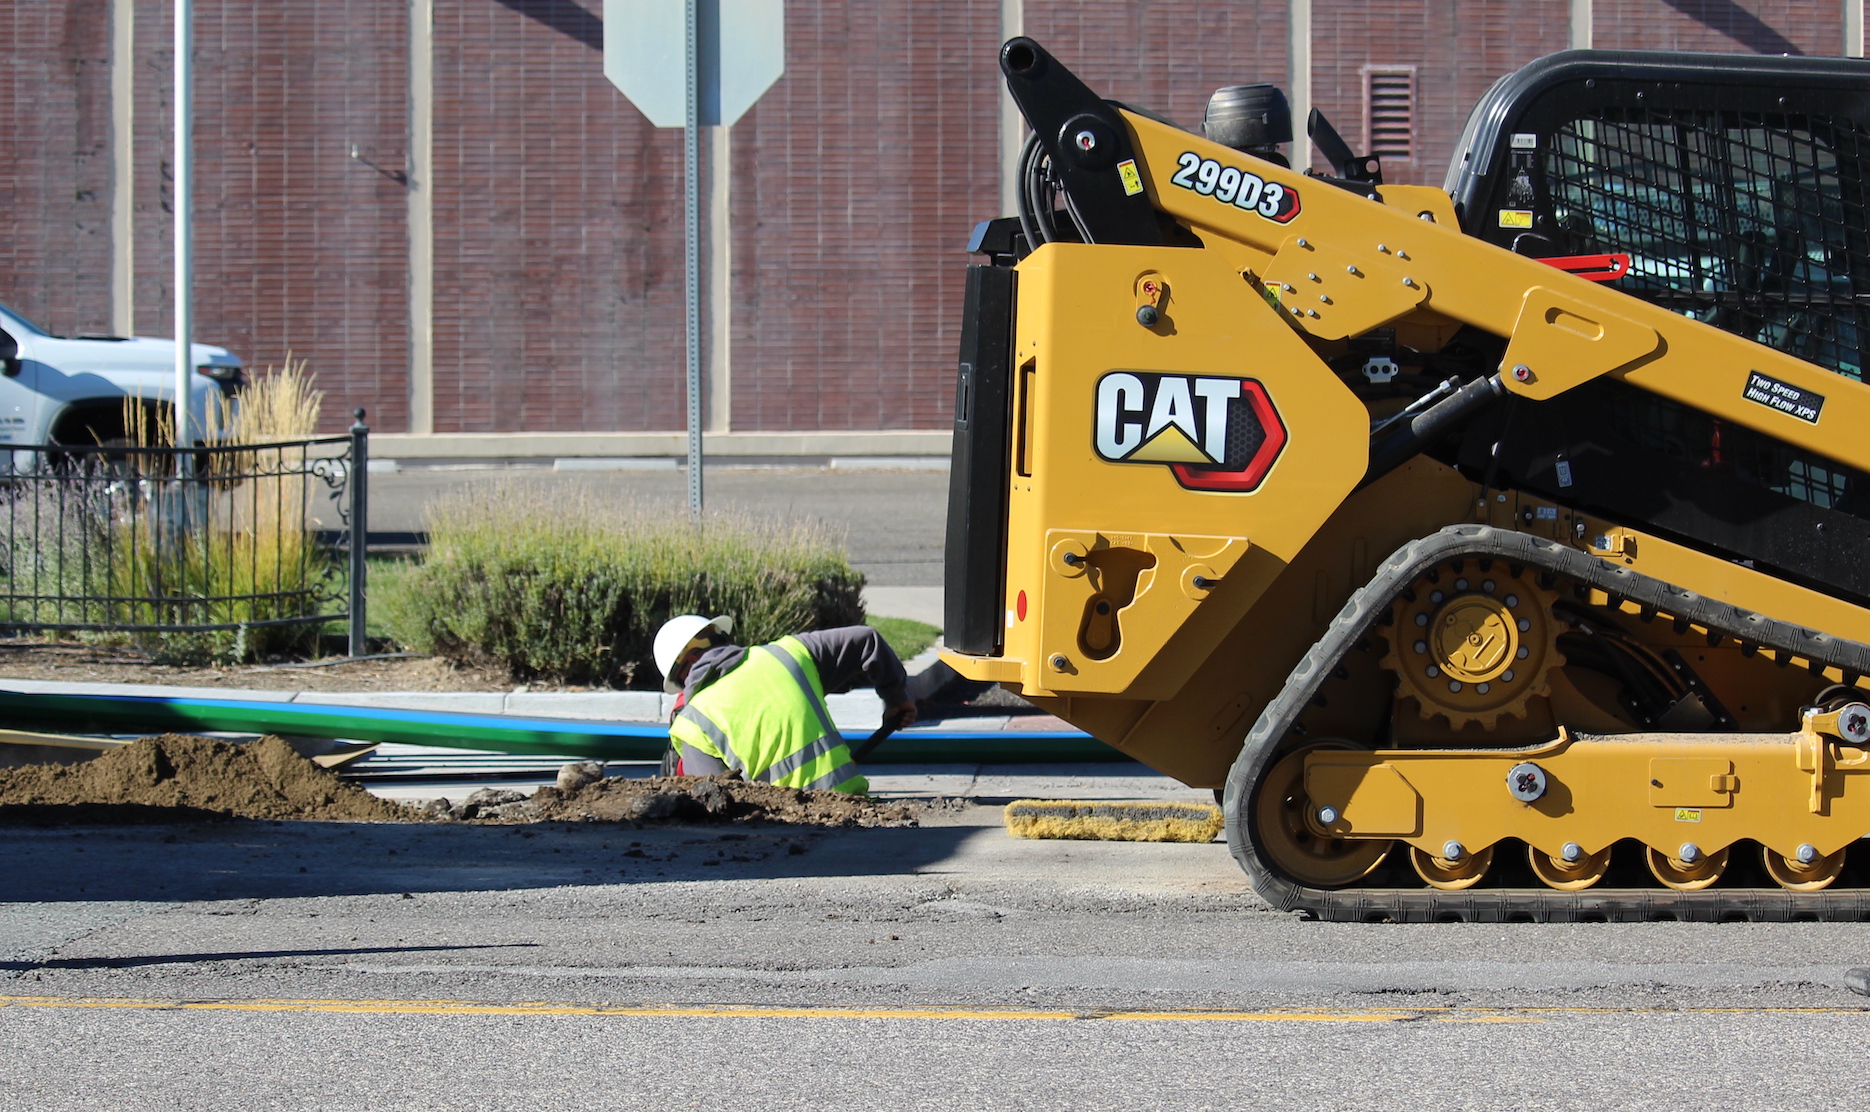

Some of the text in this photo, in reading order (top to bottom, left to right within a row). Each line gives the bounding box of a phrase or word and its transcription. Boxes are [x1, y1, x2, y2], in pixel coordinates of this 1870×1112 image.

[1171, 152, 1284, 218] 299D3
[1746, 387, 1817, 420] HIGH FLOW XPS
[1750, 374, 1801, 401] TWO SPEED
[1096, 372, 1241, 464] CAT
